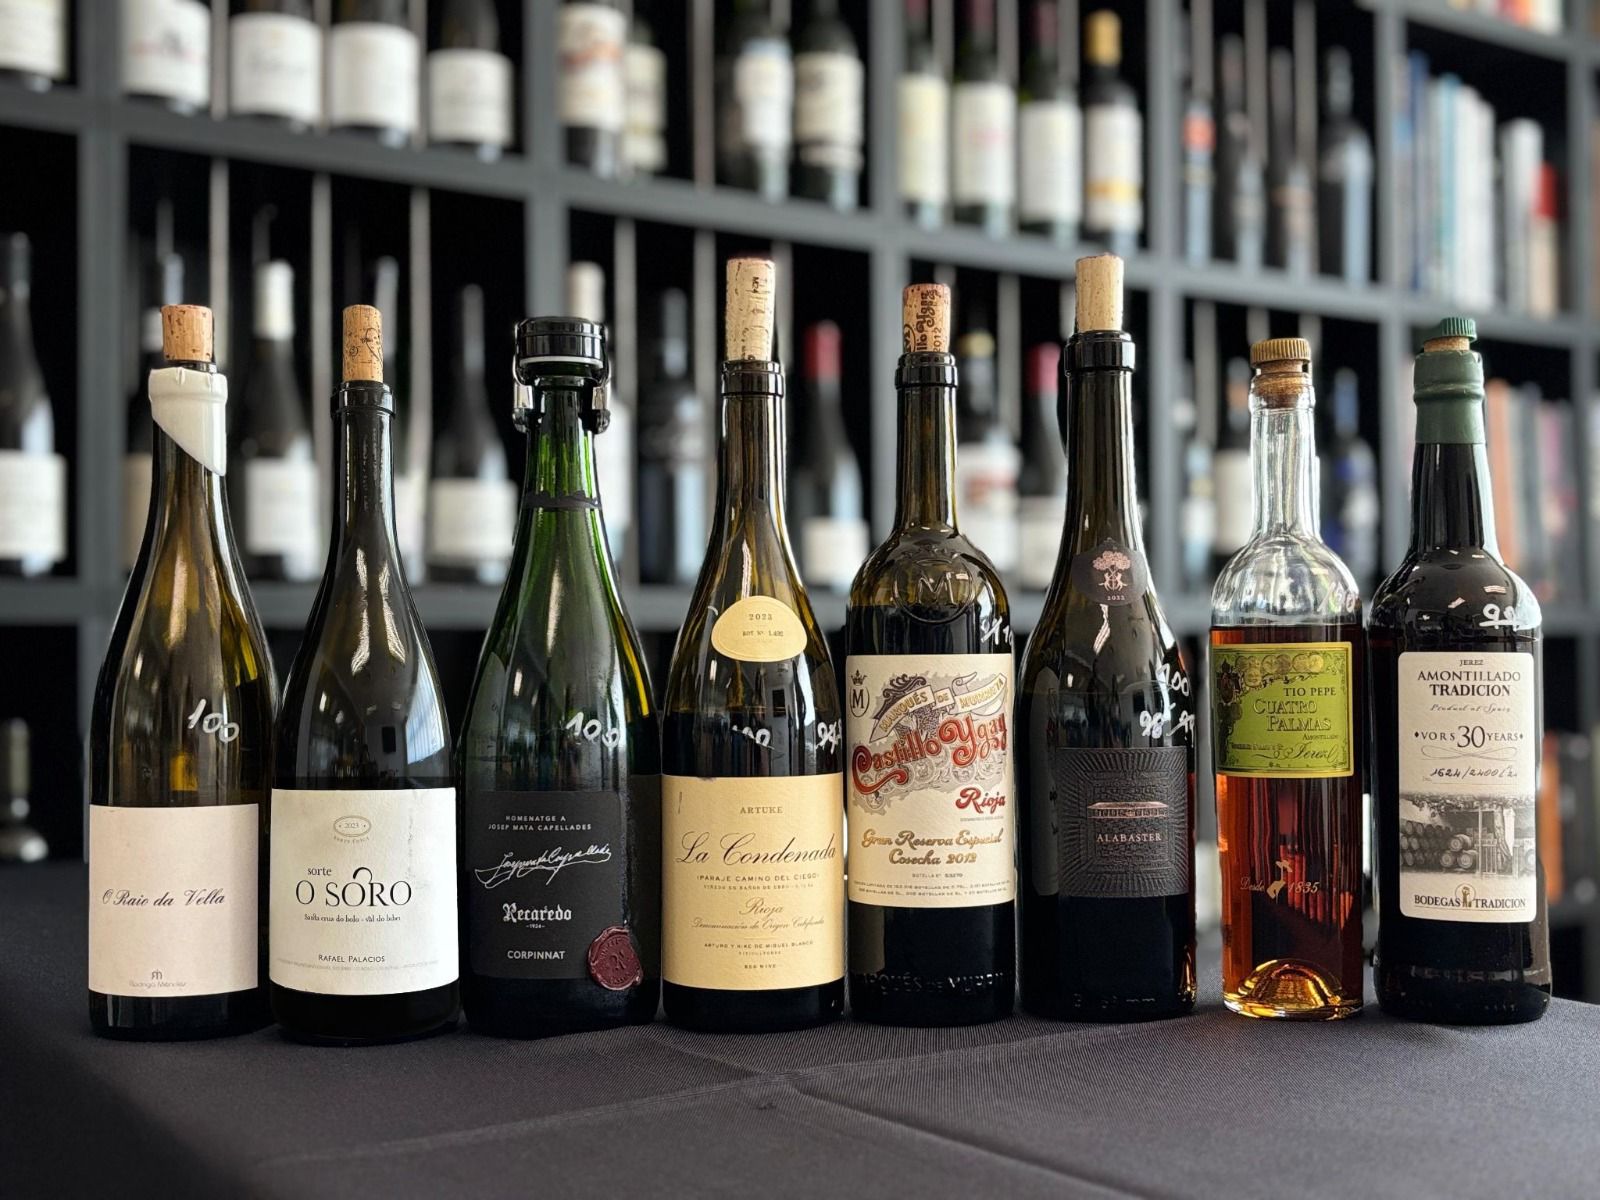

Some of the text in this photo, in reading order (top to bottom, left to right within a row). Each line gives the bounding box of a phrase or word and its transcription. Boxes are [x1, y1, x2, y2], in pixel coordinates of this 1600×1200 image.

[1459, 659, 1484, 667] JEREZ
[1417, 670, 1521, 681] AMONTILLADO
[1284, 686, 1337, 697] TIO PEPE
[1429, 684, 1511, 697] TRADICION
[852, 688, 865, 710] M
[1253, 699, 1317, 715] CUATRO
[879, 691, 929, 733] MARQUÉS
[937, 693, 949, 703] DE
[187, 698, 240, 743] 100
[1266, 715, 1332, 732] PALMAS
[565, 711, 619, 748] 100
[1457, 725, 1486, 748] 30
[1487, 733, 1518, 741] YEARS
[955, 787, 1006, 814] Rioja
[739, 806, 784, 815] ARTUKE
[488, 823, 510, 831] JOSEP
[537, 823, 592, 831] CAPELLADES
[505, 815, 556, 823] HOMENATGE
[861, 828, 1004, 851] Gran Reserva Especial
[1096, 832, 1162, 843] ALABASTER
[676, 830, 836, 867] La Condenada
[889, 848, 978, 865] Cosecha 2012
[307, 866, 332, 876] sorte
[295, 879, 315, 905] O
[1288, 881, 1320, 894] 1835
[113, 888, 148, 906] Raio
[153, 891, 174, 906] da
[183, 887, 225, 906] Vella
[1414, 894, 1526, 908] BODEGAS TRADICION
[502, 902, 572, 923] Recaredo
[739, 896, 784, 918] Rioja
[348, 955, 386, 963] PALACIOS
[507, 950, 566, 960] CORPINNAT
